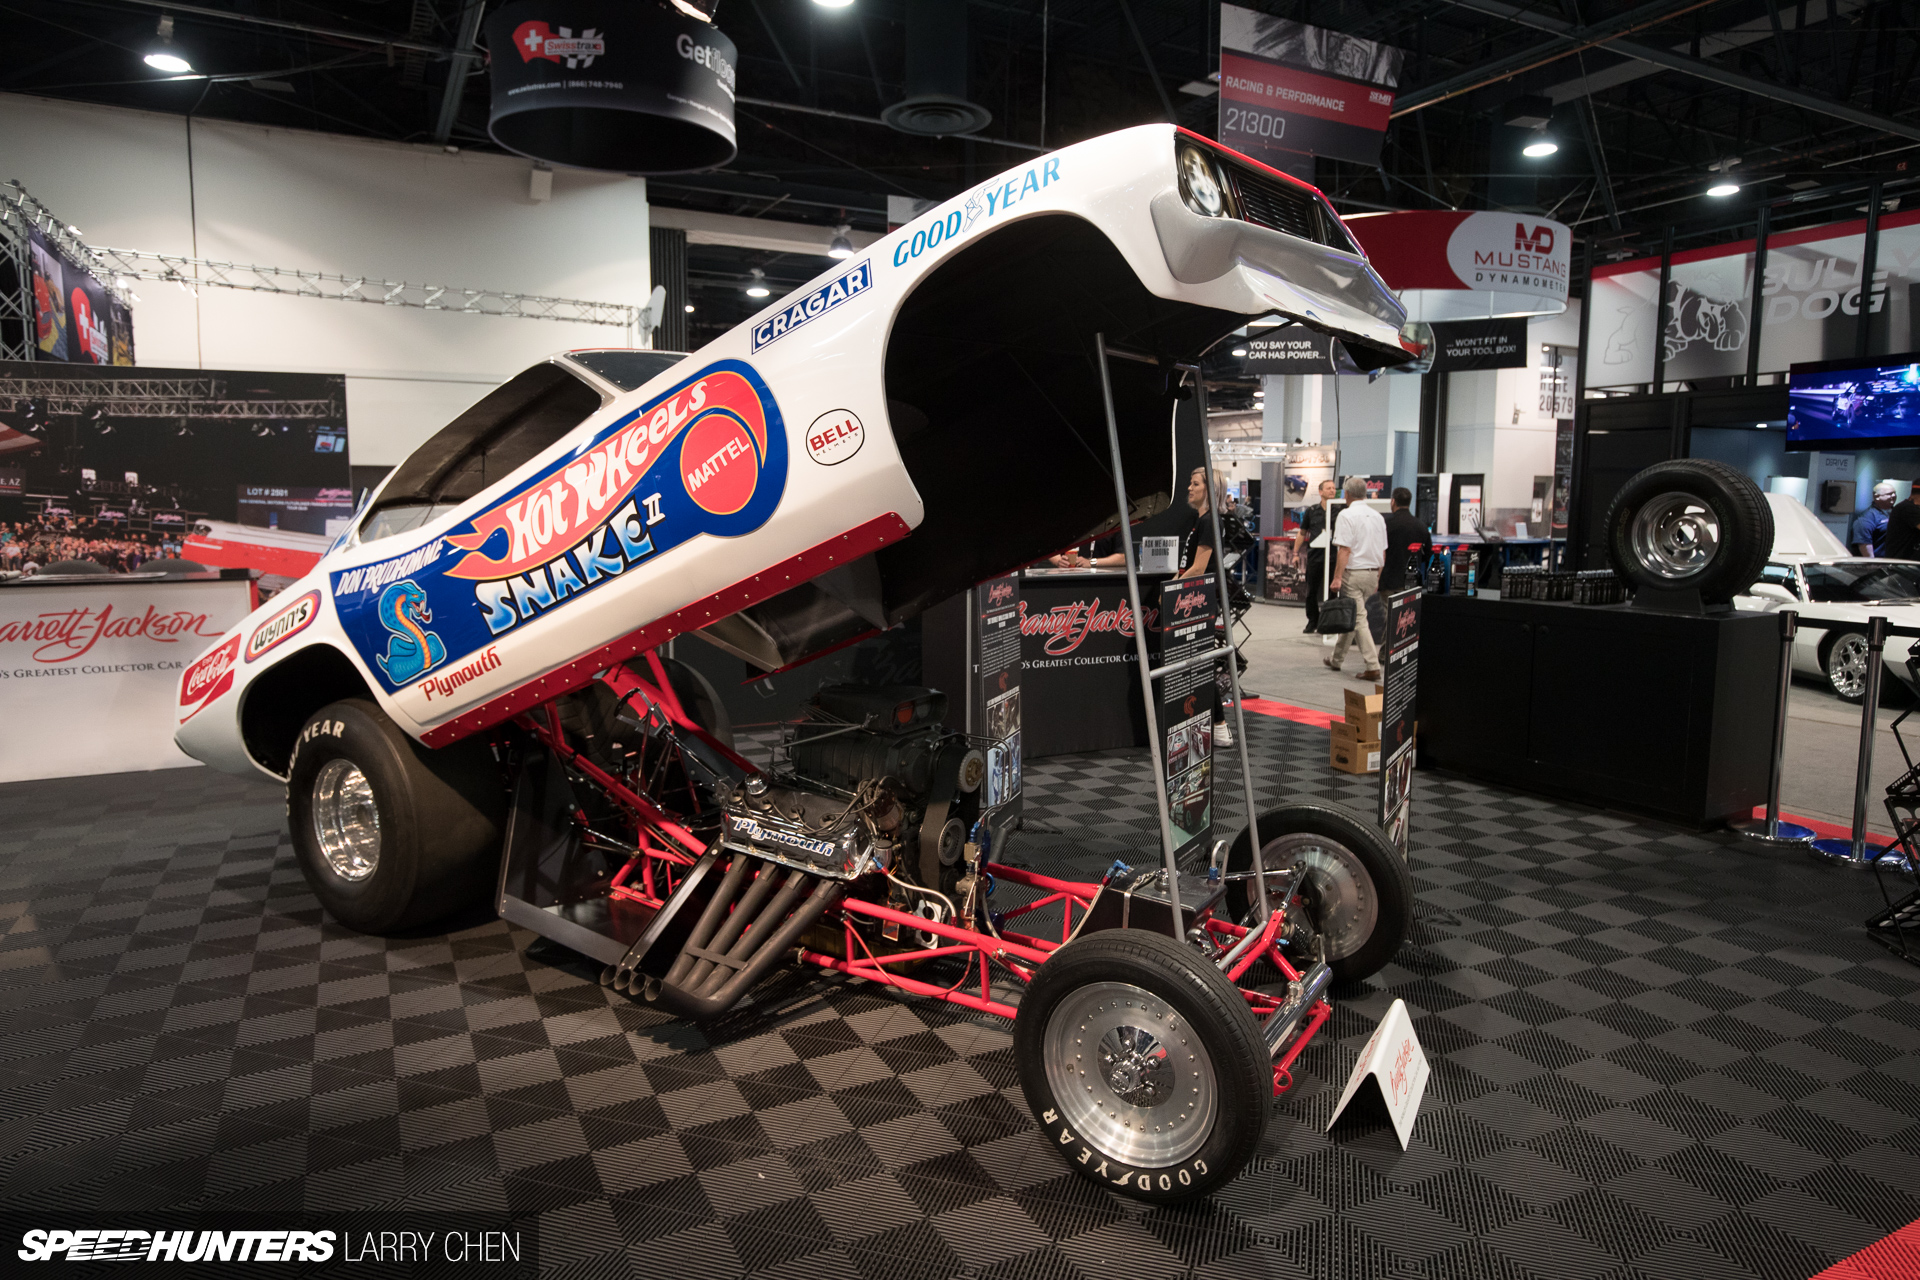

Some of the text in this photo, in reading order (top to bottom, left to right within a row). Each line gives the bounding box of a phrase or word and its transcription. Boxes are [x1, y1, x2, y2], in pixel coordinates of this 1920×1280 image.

[1226, 76, 1345, 112] RACING & PERFORMANCE
[1225, 108, 1286, 139] 21300
[1515, 223, 1554, 255] MD
[1475, 250, 1566, 278] MUSTANG
[1476, 273, 1566, 293] DYNAMOMETER
[755, 268, 866, 345] CRAGAR
[1765, 283, 1888, 325] DOG
[1248, 351, 1267, 359] CAR
[1268, 351, 1286, 359] HAS
[1249, 341, 1311, 349] YOU SAY YOUR
[1446, 345, 1517, 357] YOUR TOOL BOX!
[1455, 337, 1483, 347] WON'T
[1484, 337, 1497, 345] FIT
[1499, 336, 1508, 344] IN
[1539, 395, 1573, 414] 20579
[809, 419, 859, 452] BELL
[816, 433, 858, 457] HELMETS
[687, 436, 751, 492] MATTEL
[247, 488, 263, 496] LOT
[335, 535, 447, 597] DON PRUDHOMME
[474, 496, 656, 636] SNAKE
[0, 604, 226, 663] arrett-Jackson
[254, 602, 308, 651] WYNN'S
[1019, 597, 1161, 656] Barrett-Jacksn
[14, 667, 77, 679] GREATEST
[82, 663, 155, 674] COLLECTOR
[157, 660, 184, 670] CAR
[418, 646, 502, 701] Plymouth
[1032, 658, 1073, 669] GREATEST
[1074, 654, 1121, 666] COLLECTOR
[730, 816, 836, 857] Plymouth
